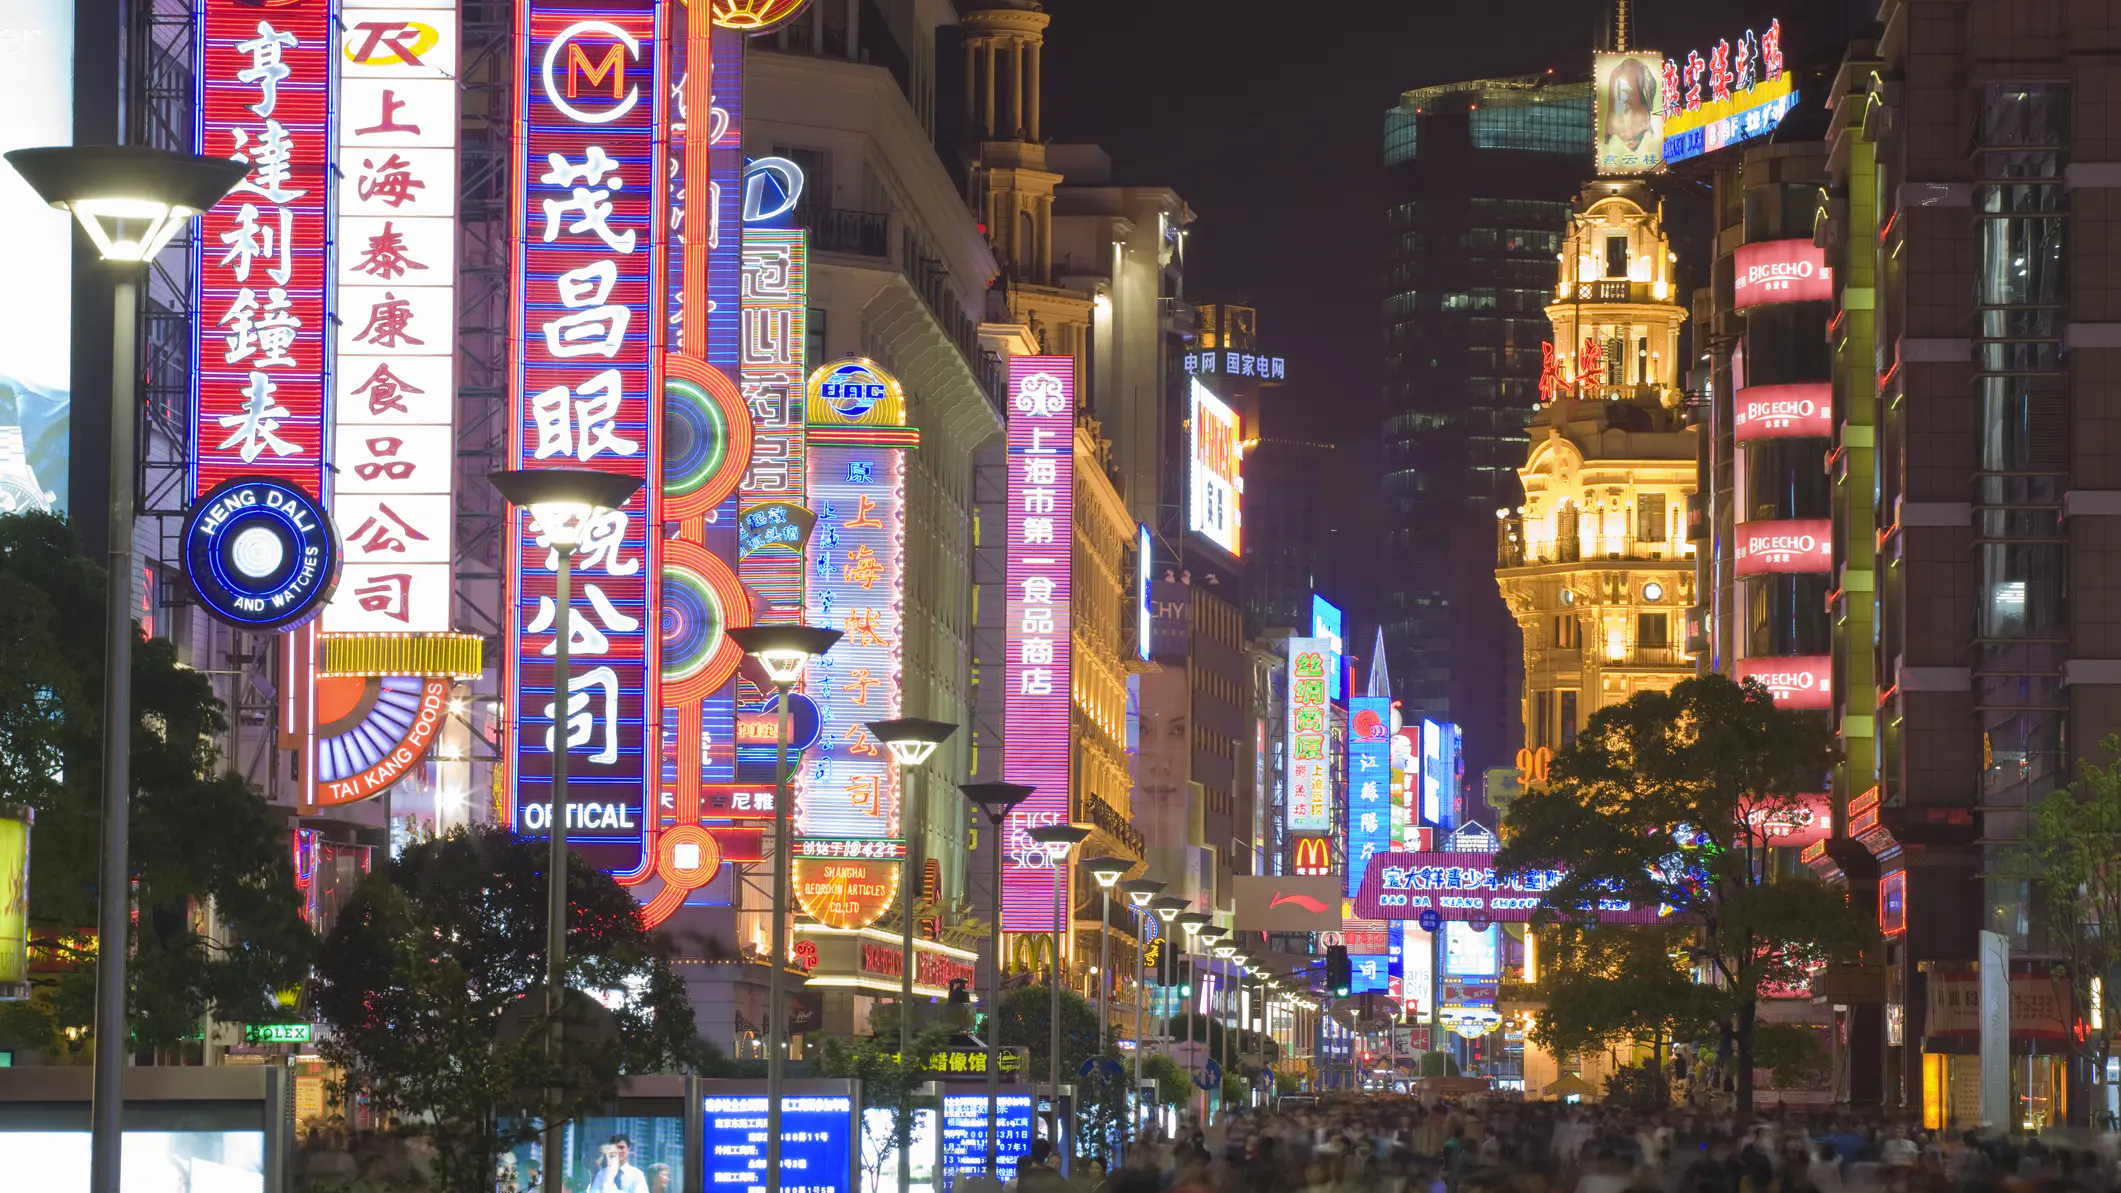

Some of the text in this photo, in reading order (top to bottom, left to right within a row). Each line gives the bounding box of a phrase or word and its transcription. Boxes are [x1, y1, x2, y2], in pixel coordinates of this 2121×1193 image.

[1748, 264, 1770, 284] BIG
[1771, 260, 1813, 278] ECHO
[345, 88, 430, 623] 上海泰康食品公司
[1226, 352, 1285, 380] 国家电网
[820, 383, 887, 400] BAC
[1748, 402, 1770, 420] BIG
[1771, 399, 1815, 417] ECHO
[845, 461, 874, 484] 原
[200, 489, 316, 536] HENG DALI
[1749, 536, 1770, 554] BIG
[1771, 535, 1815, 552] ECHO
[1021, 426, 1057, 695] 上海市第一食品商店
[233, 595, 266, 613] AND
[270, 546, 320, 610] WATCHES
[1771, 671, 1814, 689] ECHO
[1293, 651, 1325, 761] 丝绸商厦
[329, 682, 443, 799] TAI KANG FOODS
[525, 803, 634, 829] OPTICAL
[803, 840, 898, 857] 创始于1942年
[823, 866, 866, 878] SHANGHAI
[847, 883, 887, 897] ARTICLES
[1379, 894, 1407, 907] BAO
[1412, 895, 1432, 908] DA
[1439, 896, 1484, 909] XIANG
[1406, 983, 1429, 999] City
[1473, 988, 1490, 998] KFC
